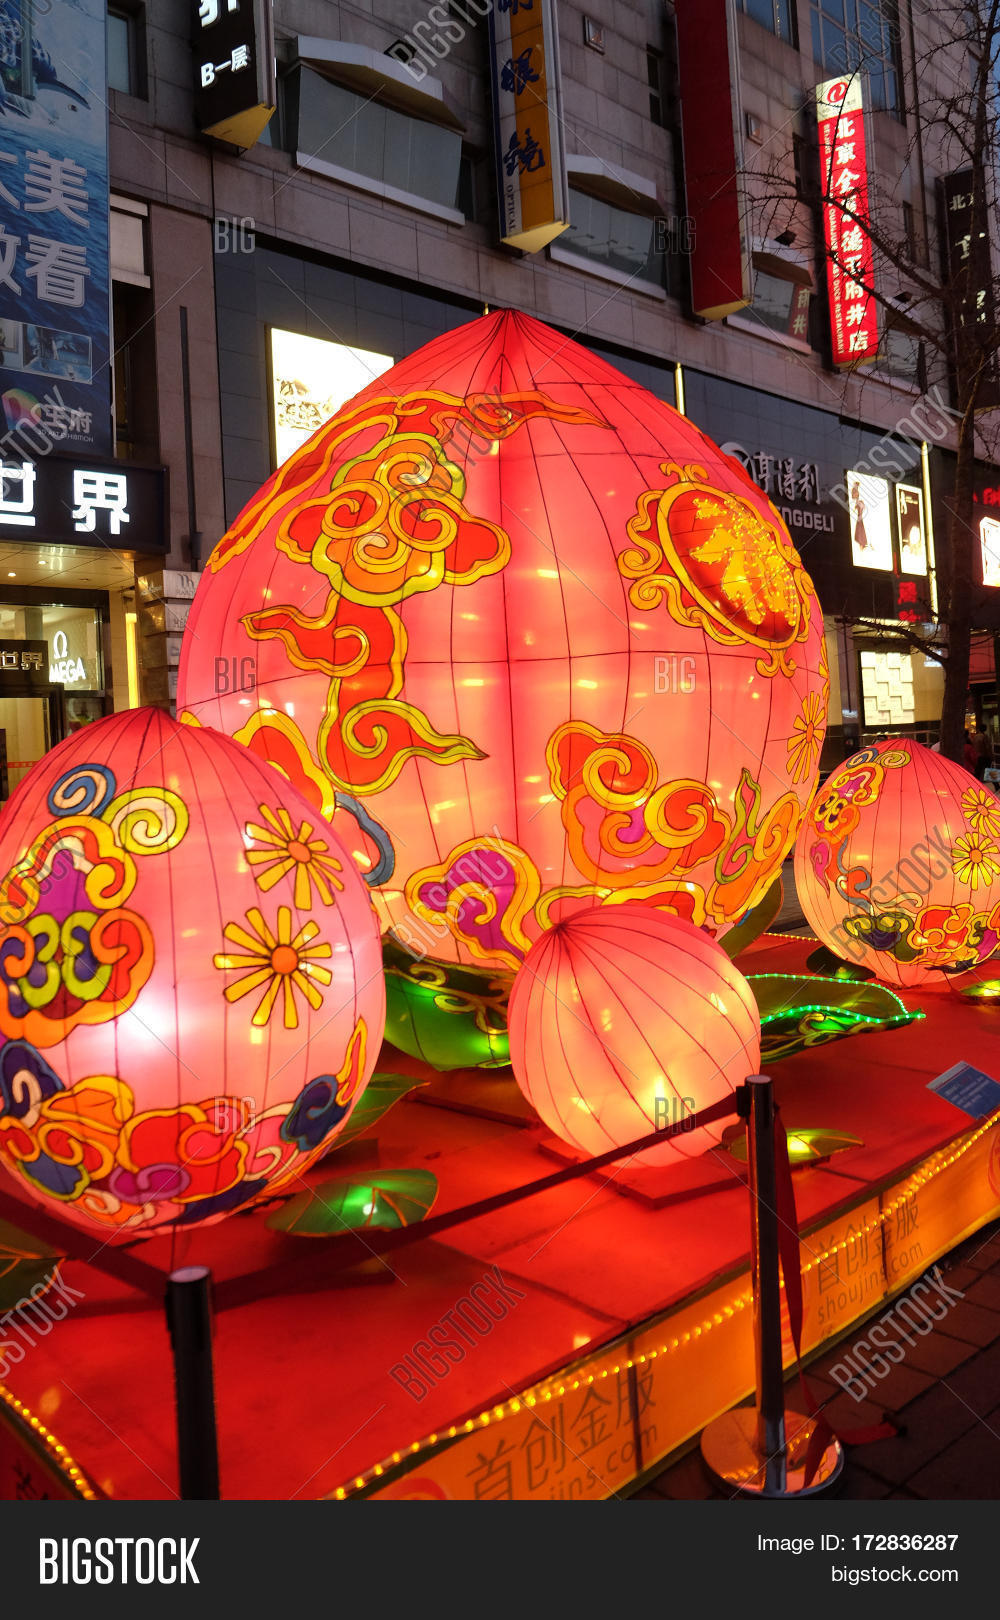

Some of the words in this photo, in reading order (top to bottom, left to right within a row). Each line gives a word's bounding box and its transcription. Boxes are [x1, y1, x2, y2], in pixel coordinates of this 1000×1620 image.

[201, 44, 248, 87] B一层
[507, 184, 516, 232] OPTICAL
[0, 459, 130, 535] 世界
[777, 505, 835, 533] NGDELI
[49, 657, 86, 684] MEGA
